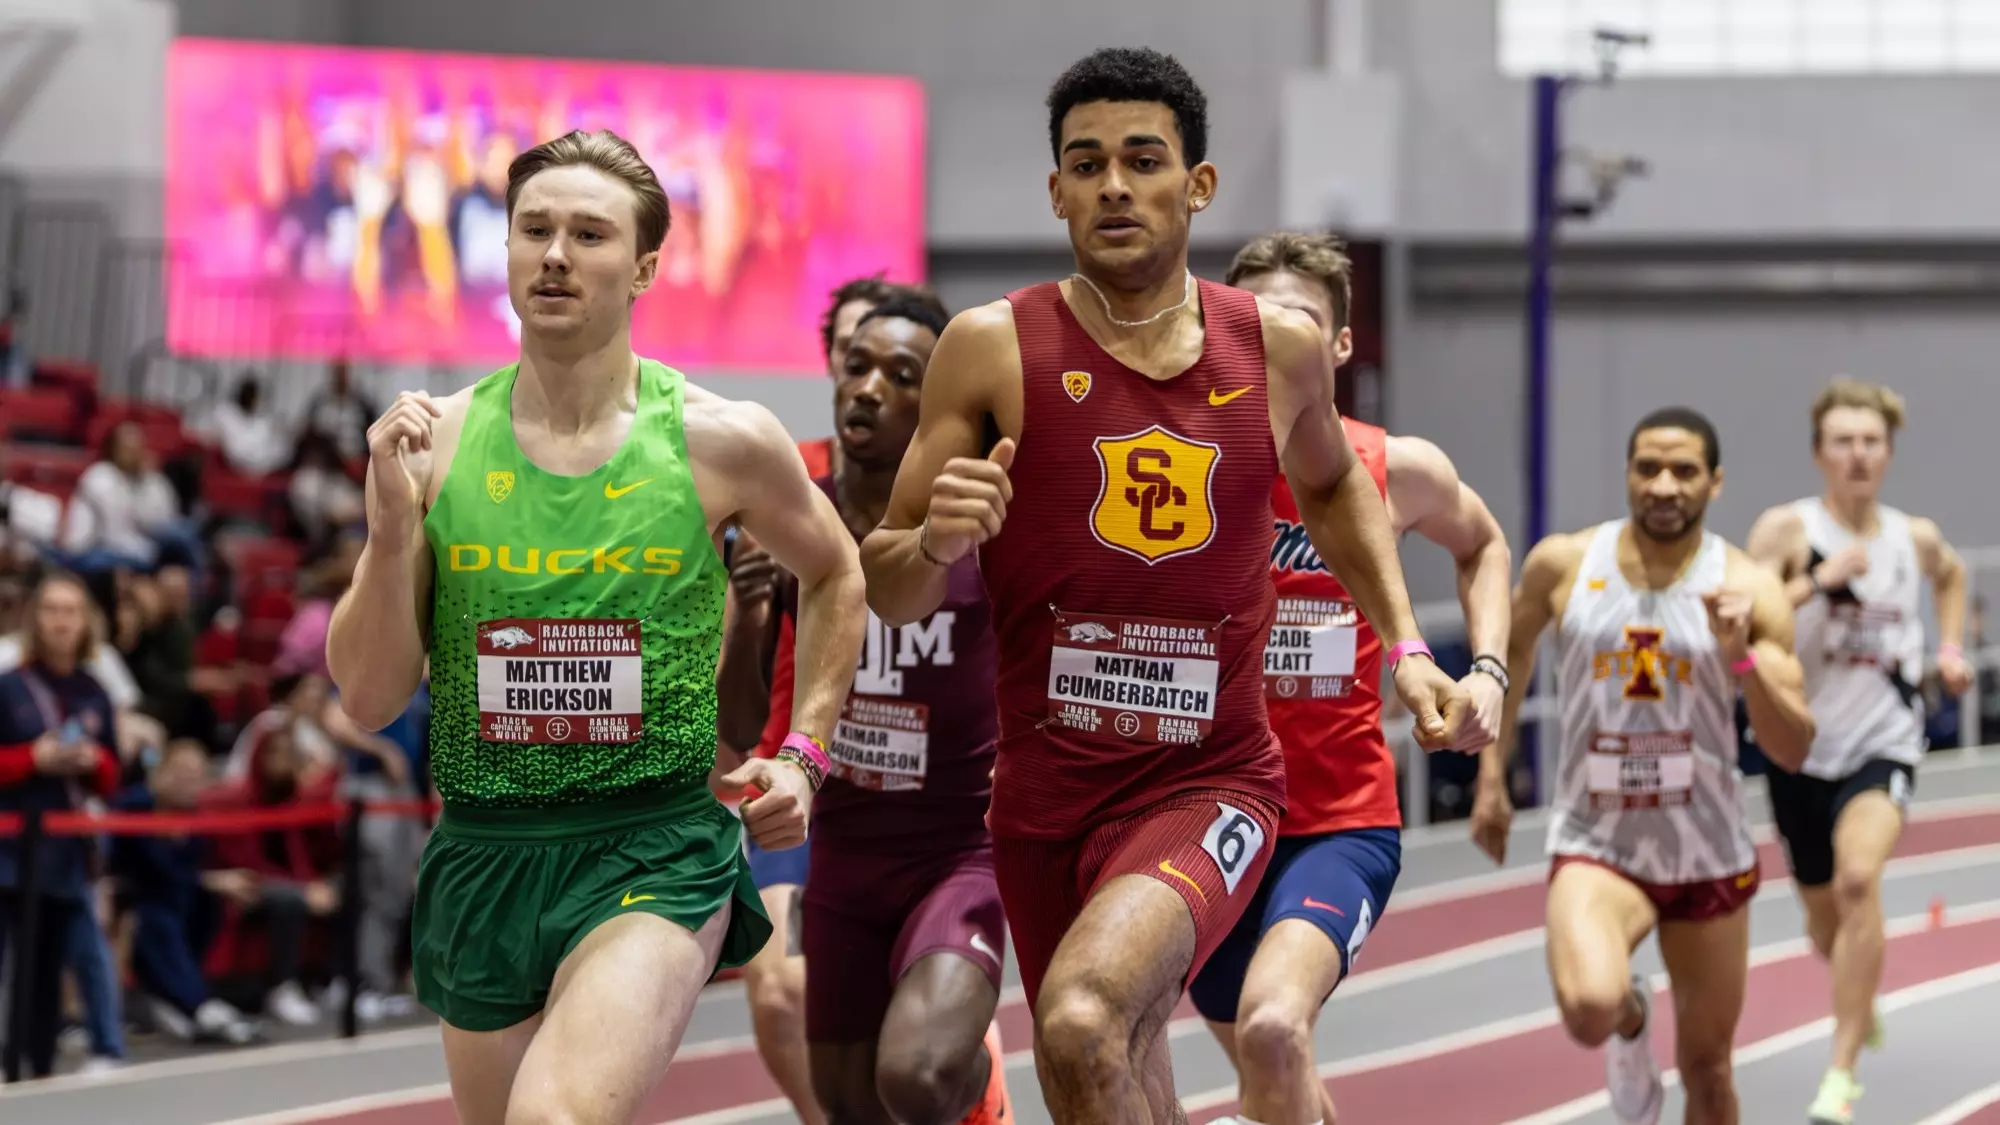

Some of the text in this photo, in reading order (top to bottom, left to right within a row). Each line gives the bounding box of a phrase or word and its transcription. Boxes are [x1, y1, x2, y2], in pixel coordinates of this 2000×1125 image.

[450, 544, 683, 576] DUCKS
[1277, 599, 1343, 613] RAZORBACK
[542, 624, 624, 638] RAZORBACK
[1123, 623, 1205, 641] RAZORBACK
[542, 638, 637, 653] INVITATIONAL
[1268, 629, 1311, 648] CADE
[1122, 637, 1216, 656] INVITATIONAL
[1264, 652, 1313, 671] FLATT
[506, 660, 612, 683] MATTHEW
[1094, 656, 1175, 682] NATHAN
[506, 688, 612, 711] ERICKSON
[1055, 674, 1209, 713] CUMBERBATCH
[1064, 703, 1097, 717] TRACK
[496, 715, 527, 726] TRACK
[589, 716, 628, 726] RANDAL
[1063, 718, 1096, 732] WORLD
[1159, 716, 1198, 730] RANDAL
[490, 723, 514, 732] CAPITAL
[522, 725, 534, 734] THE
[495, 730, 529, 741] WORLD
[588, 725, 609, 733] TYSON
[840, 724, 888, 747] KIMAR
[1157, 725, 1199, 737] TYSON TRACK
[590, 731, 628, 741] CENTER
[1217, 813, 1256, 874] 6
